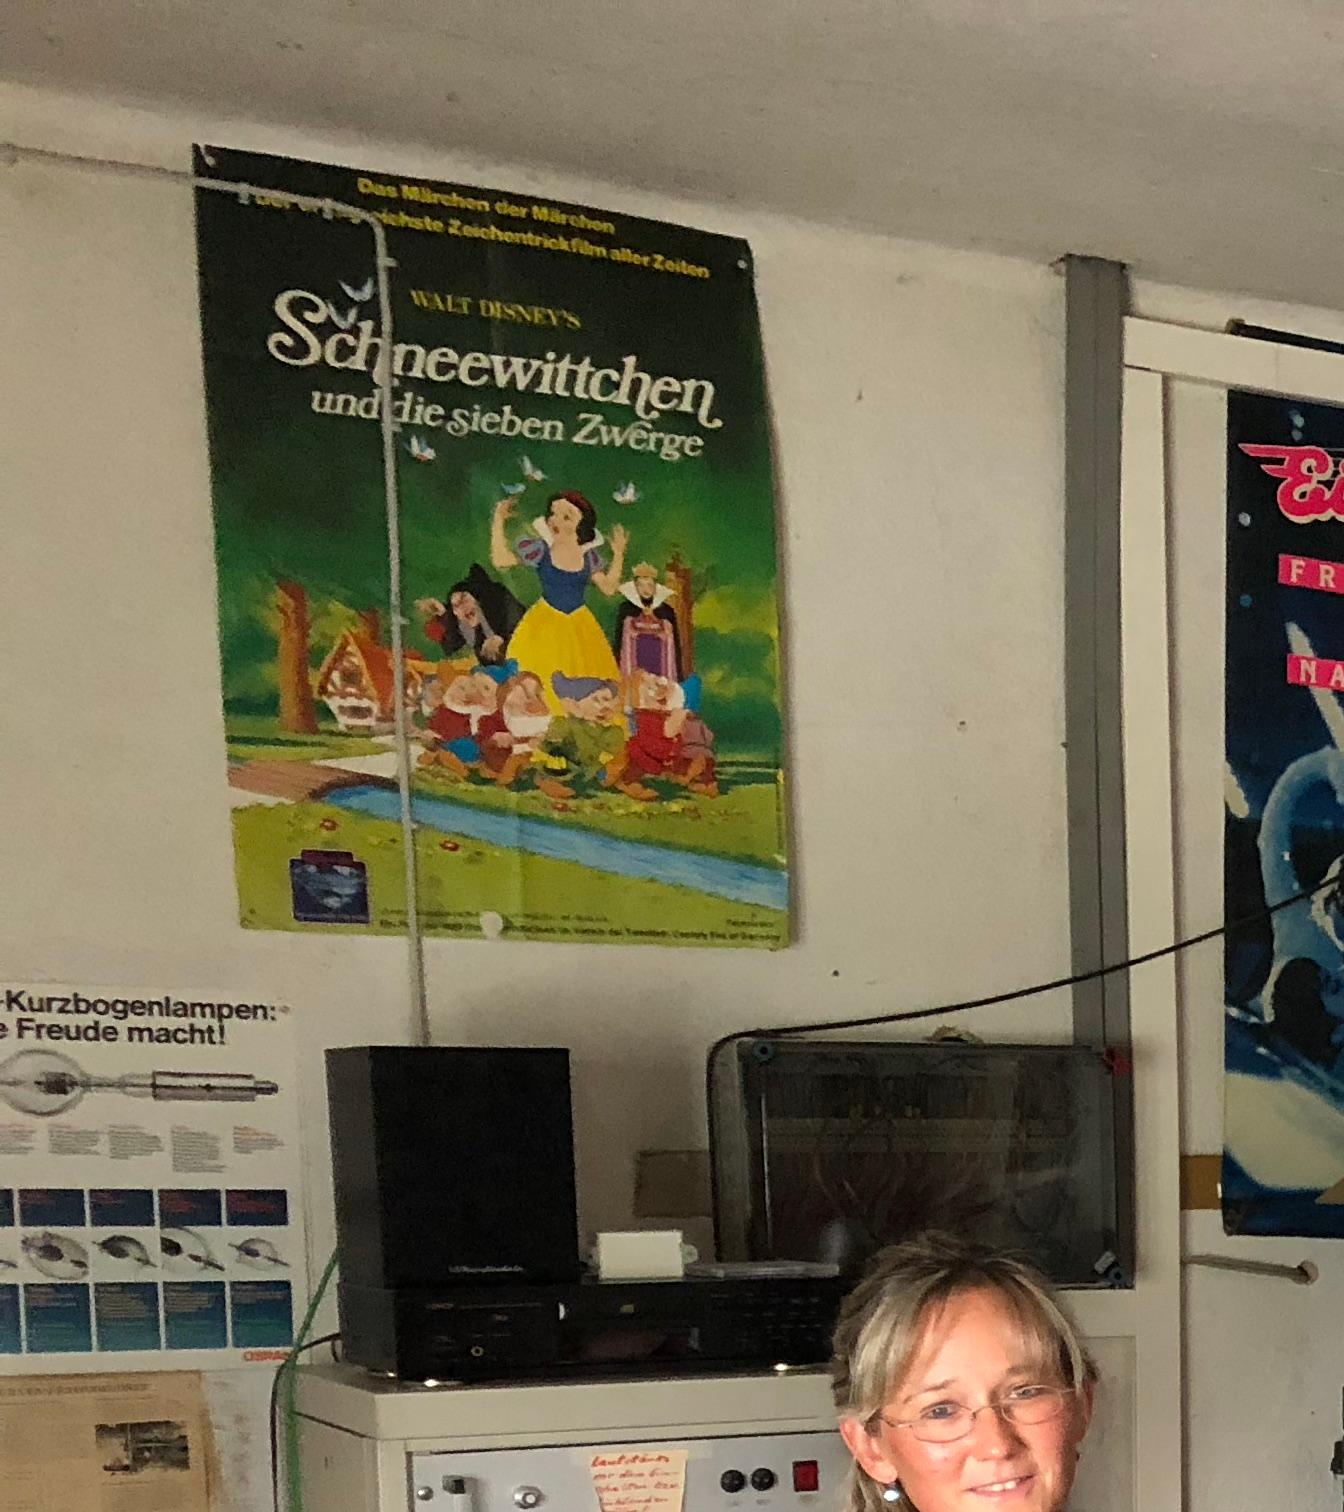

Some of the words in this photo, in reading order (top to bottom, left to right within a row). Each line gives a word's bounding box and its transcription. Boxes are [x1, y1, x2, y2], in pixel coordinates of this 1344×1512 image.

[357, 176, 399, 198] Das
[401, 184, 490, 213] Märchen
[494, 200, 528, 218] der
[531, 204, 616, 235] Märchen
[447, 218, 608, 259] Zeichentrickfilm
[609, 247, 650, 268] aller
[651, 252, 712, 279] Zeiten
[409, 289, 470, 317] WALT
[479, 298, 583, 331] DISNEY'S
[267, 288, 723, 430] Schneewittchen
[311, 388, 382, 422] und
[396, 389, 444, 428] die
[446, 404, 565, 443] sieben
[572, 411, 704, 462] Zwerge
[16, 1017, 119, 1042] Freude
[127, 1021, 227, 1047] macht!
